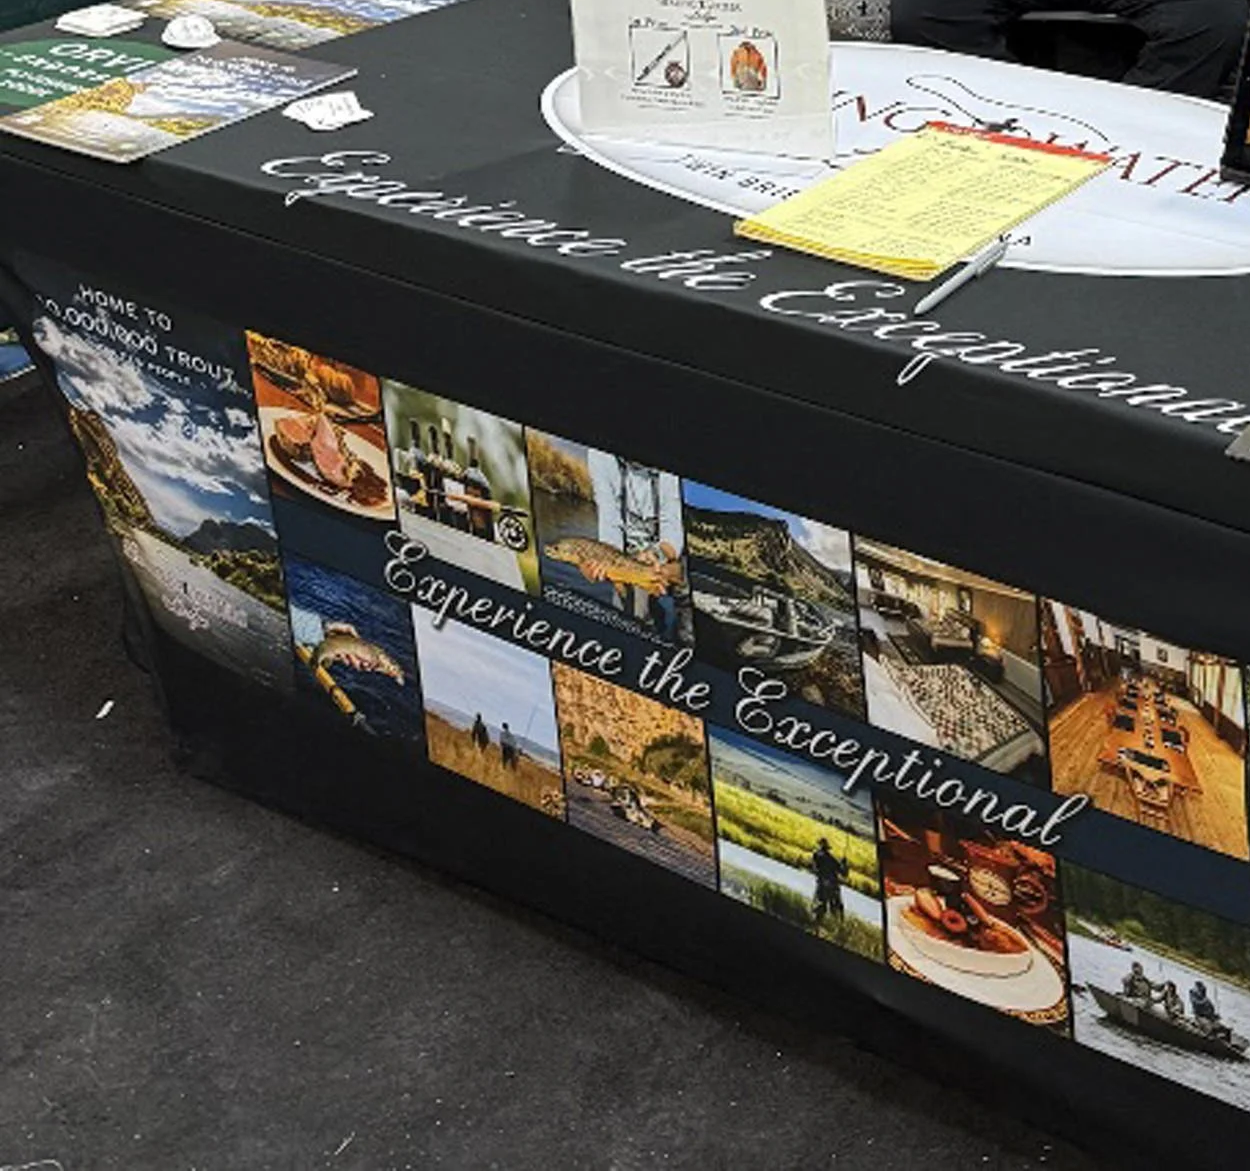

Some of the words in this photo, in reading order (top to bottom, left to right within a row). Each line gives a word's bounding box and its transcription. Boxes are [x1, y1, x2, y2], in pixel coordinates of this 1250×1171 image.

[49, 43, 157, 74] ORVI
[260, 150, 627, 257] Experience
[620, 248, 773, 290] the
[78, 282, 139, 321] HOME
[143, 306, 173, 332] TO
[164, 345, 235, 387] TROUT
[384, 530, 623, 676] Experience
[638, 647, 712, 710] the
[734, 666, 1090, 846] Exceptional
